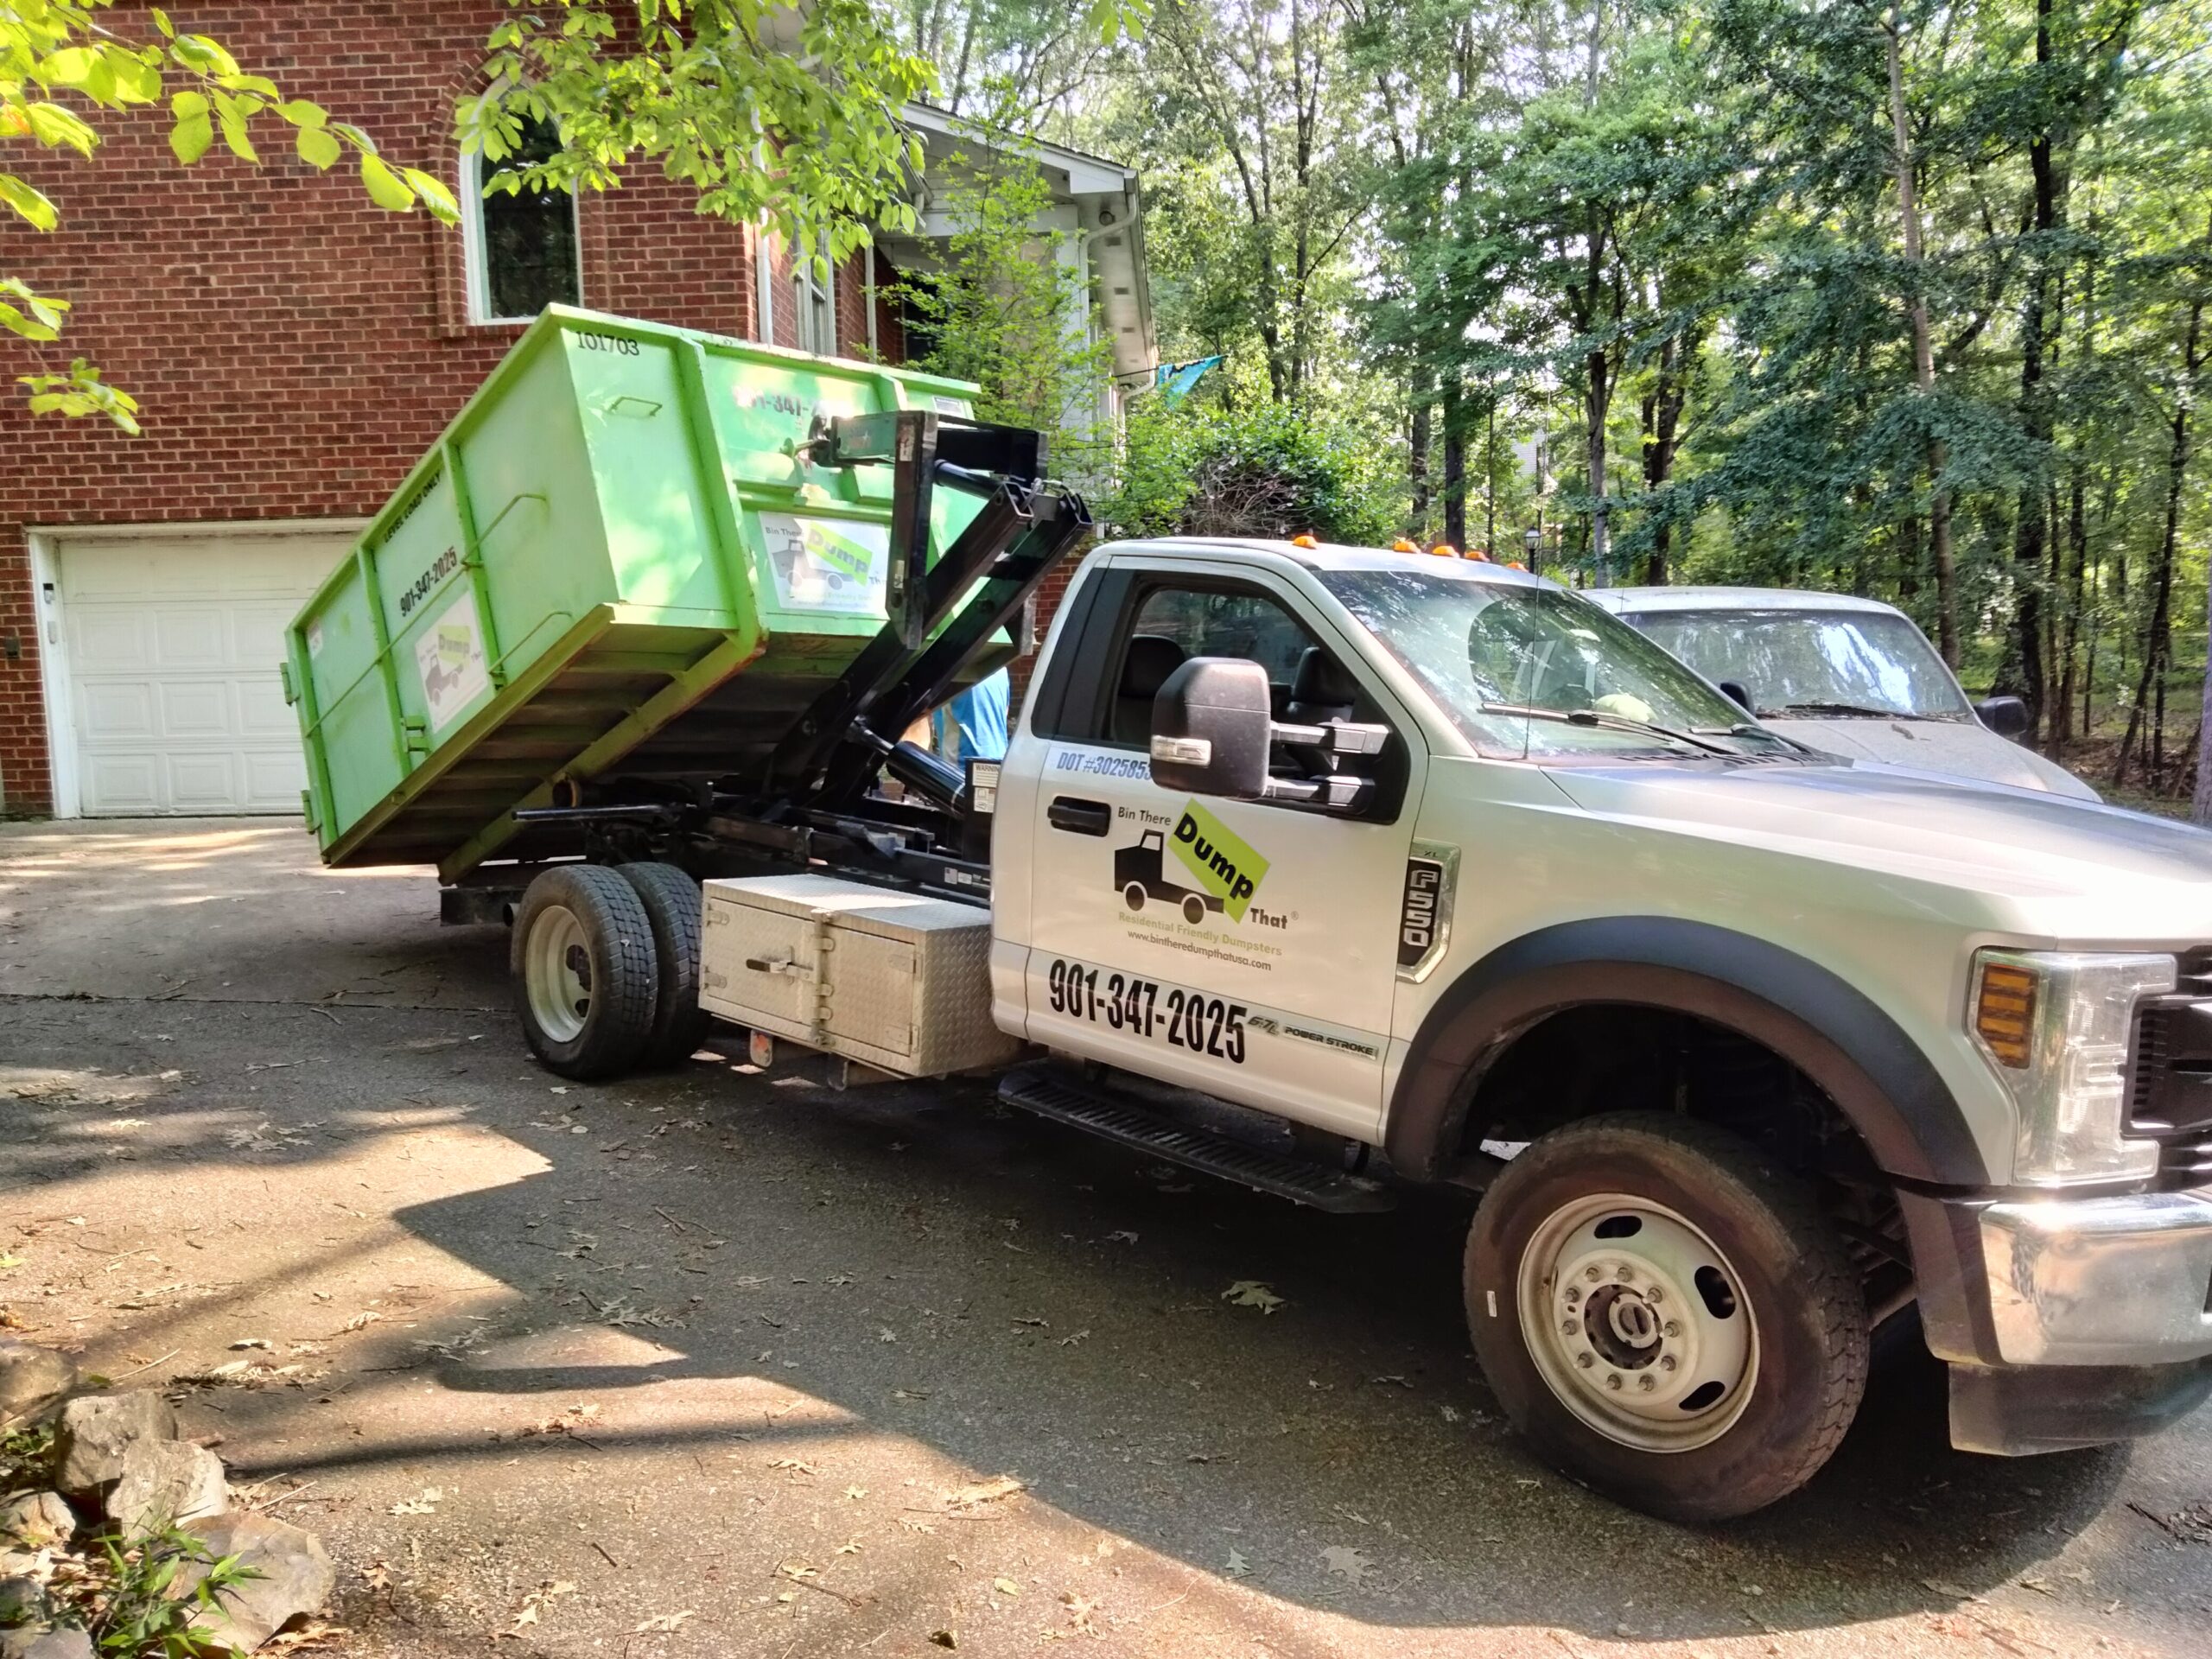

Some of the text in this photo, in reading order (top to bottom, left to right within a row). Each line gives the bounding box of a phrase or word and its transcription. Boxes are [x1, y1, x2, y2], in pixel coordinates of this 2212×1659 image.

[576, 331, 639, 356] 101703
[385, 516, 404, 543] LEVEL
[766, 527, 779, 536] Bin
[809, 528, 869, 573] Dump
[399, 545, 458, 618] 901-347-2025
[975, 764, 1000, 773] WARNIN
[1057, 752, 1085, 772] DOT
[1118, 806, 1172, 826] Bin There
[1173, 812, 1254, 900] Dump
[1249, 907, 1287, 930] That
[1403, 869, 1439, 947] F550
[1119, 912, 1282, 957] Residential Friendly Dumpsters
[1128, 930, 1272, 971] www.bintheredumpthatusa.com
[1049, 959, 1248, 1064] 901-347-2025
[1285, 1027, 1324, 1043] POWER
[1325, 1037, 1374, 1056] STROKE
